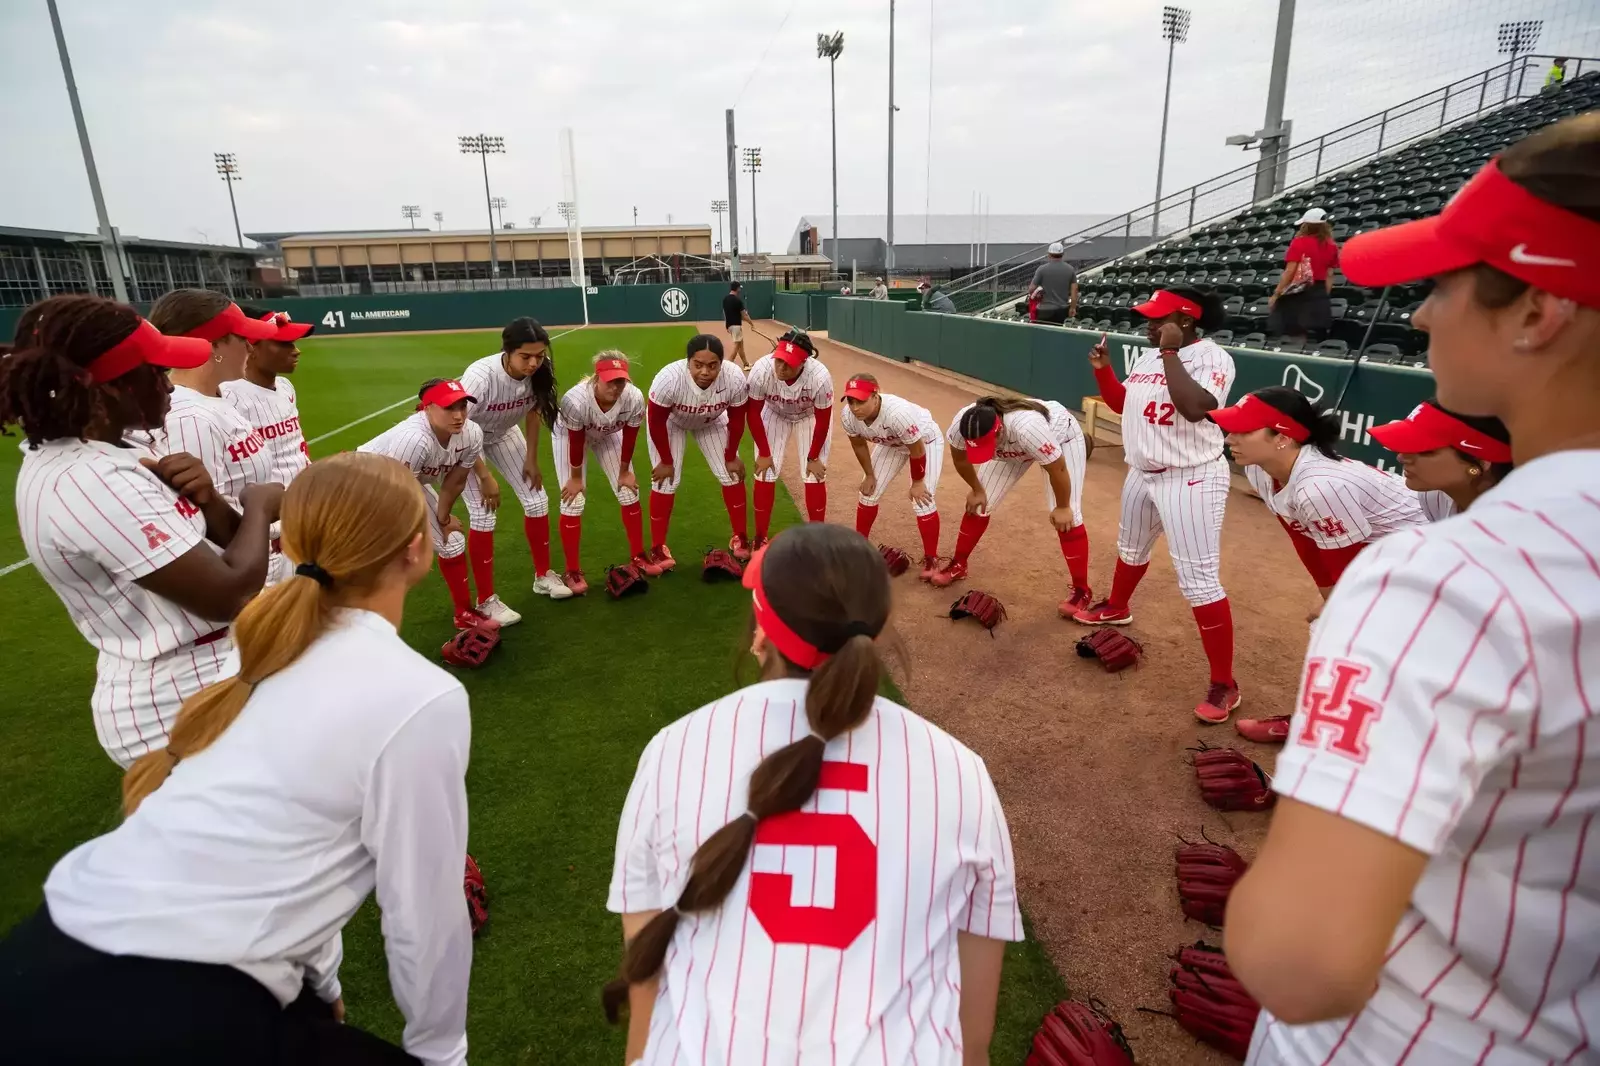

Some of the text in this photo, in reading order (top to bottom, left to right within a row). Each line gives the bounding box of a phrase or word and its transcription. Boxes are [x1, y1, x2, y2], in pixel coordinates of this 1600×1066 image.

[663, 290, 686, 315] SEC
[322, 309, 410, 328] 41 ALL AMERICANS
[671, 401, 730, 414] HOUSTON
[1143, 401, 1175, 426] 42
[1313, 516, 1350, 538] UH
[1297, 656, 1383, 765] UH
[748, 761, 877, 950] 5
